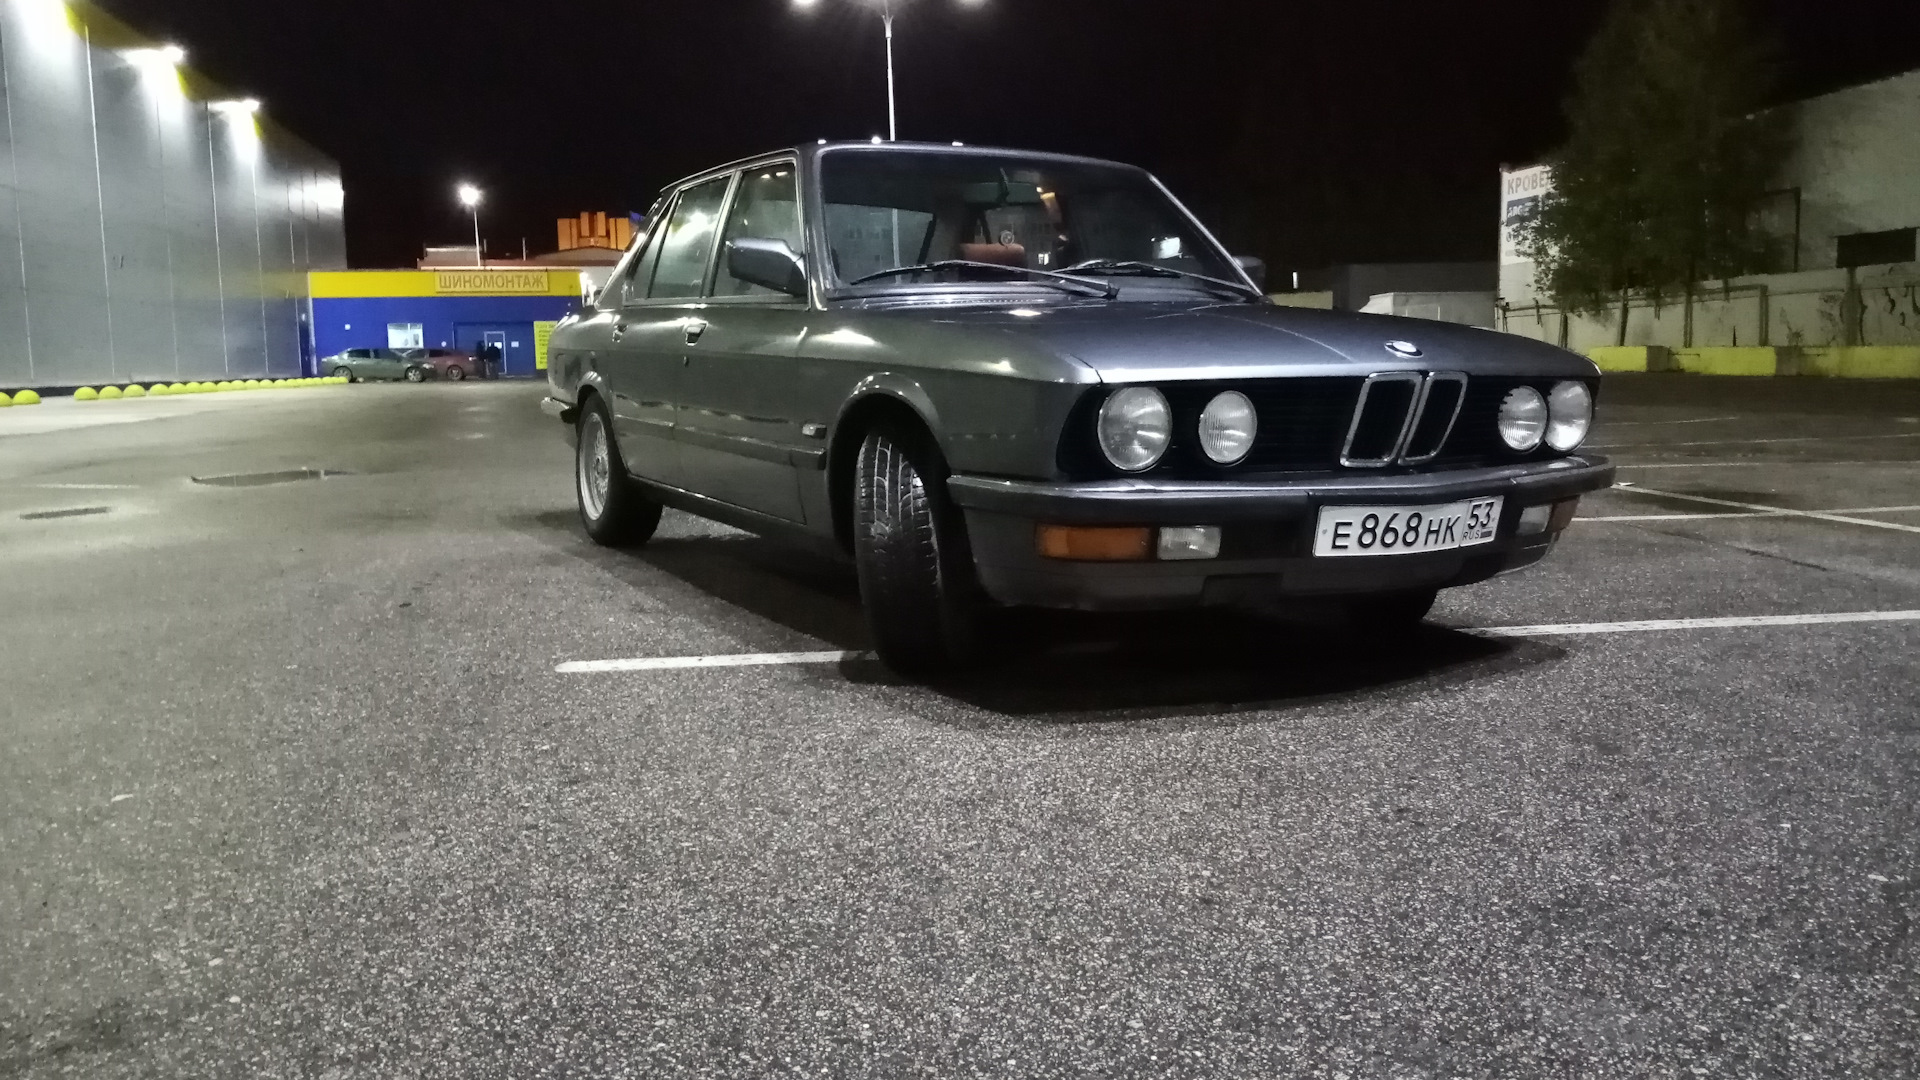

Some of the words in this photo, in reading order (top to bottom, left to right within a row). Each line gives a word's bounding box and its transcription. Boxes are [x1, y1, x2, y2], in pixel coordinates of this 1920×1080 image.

[439, 274, 545, 289] ШИНОМОНТАЖ
[1467, 501, 1496, 528] 53
[1462, 531, 1480, 541] RUS
